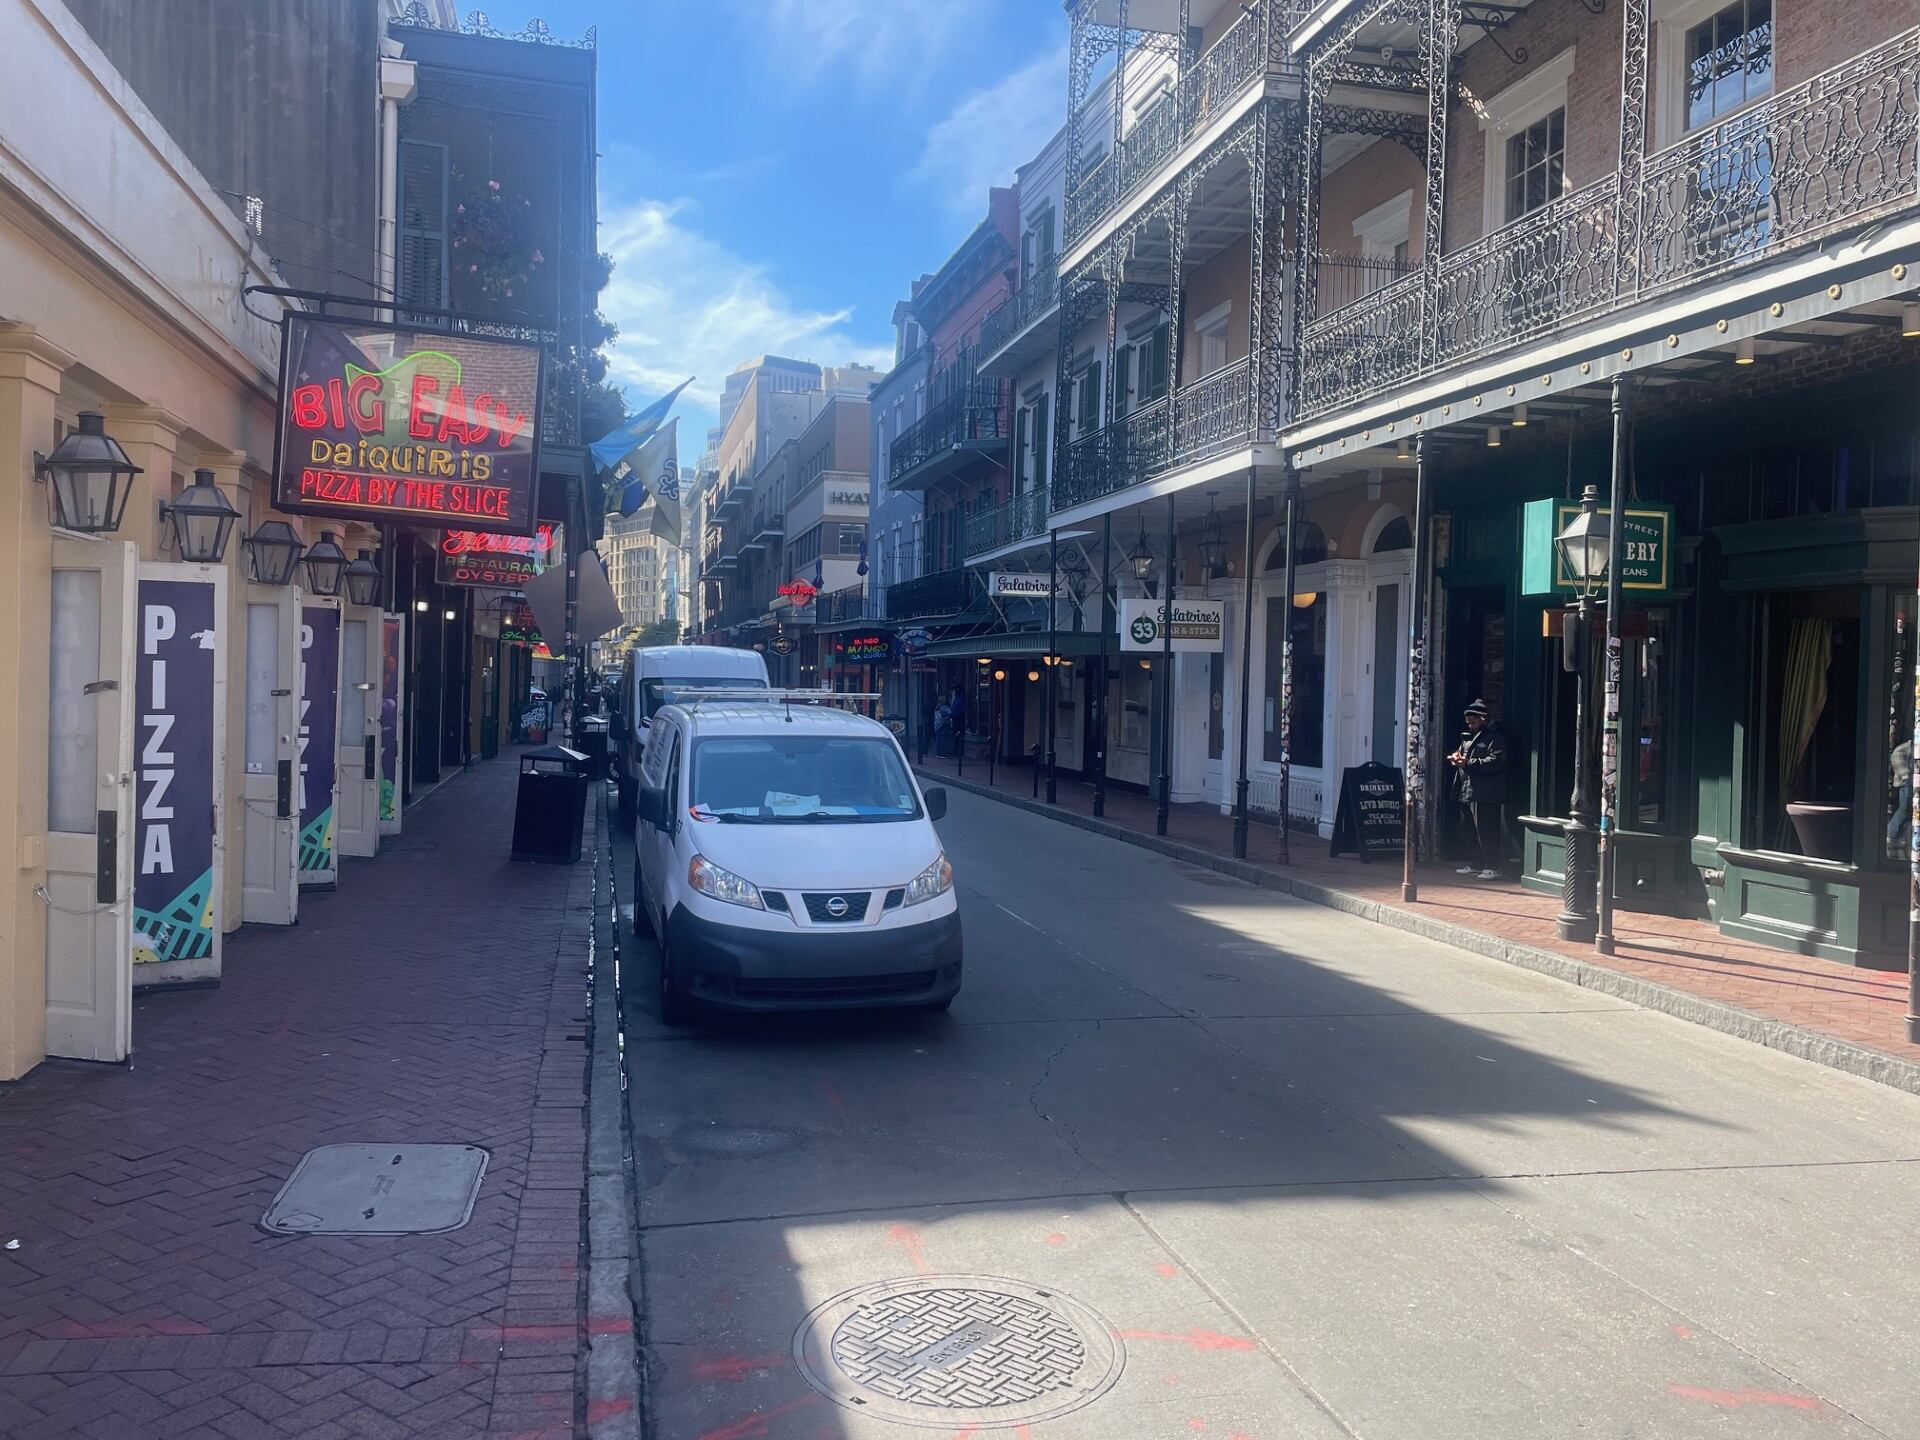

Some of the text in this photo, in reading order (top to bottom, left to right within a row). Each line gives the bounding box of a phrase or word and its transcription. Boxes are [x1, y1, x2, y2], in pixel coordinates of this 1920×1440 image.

[292, 374, 526, 448] BIG EASY
[301, 470, 510, 516] PIZZA BY THE SLICE
[832, 490, 870, 505] HYAT
[455, 568, 537, 584] OYSTER
[1623, 567, 1649, 576] EANS
[998, 576, 1062, 593] Galatoires
[1157, 605, 1221, 624] Glatoire's
[1133, 622, 1154, 639] 33
[1189, 627, 1217, 635] STEAK
[141, 604, 176, 874] PIZZA
